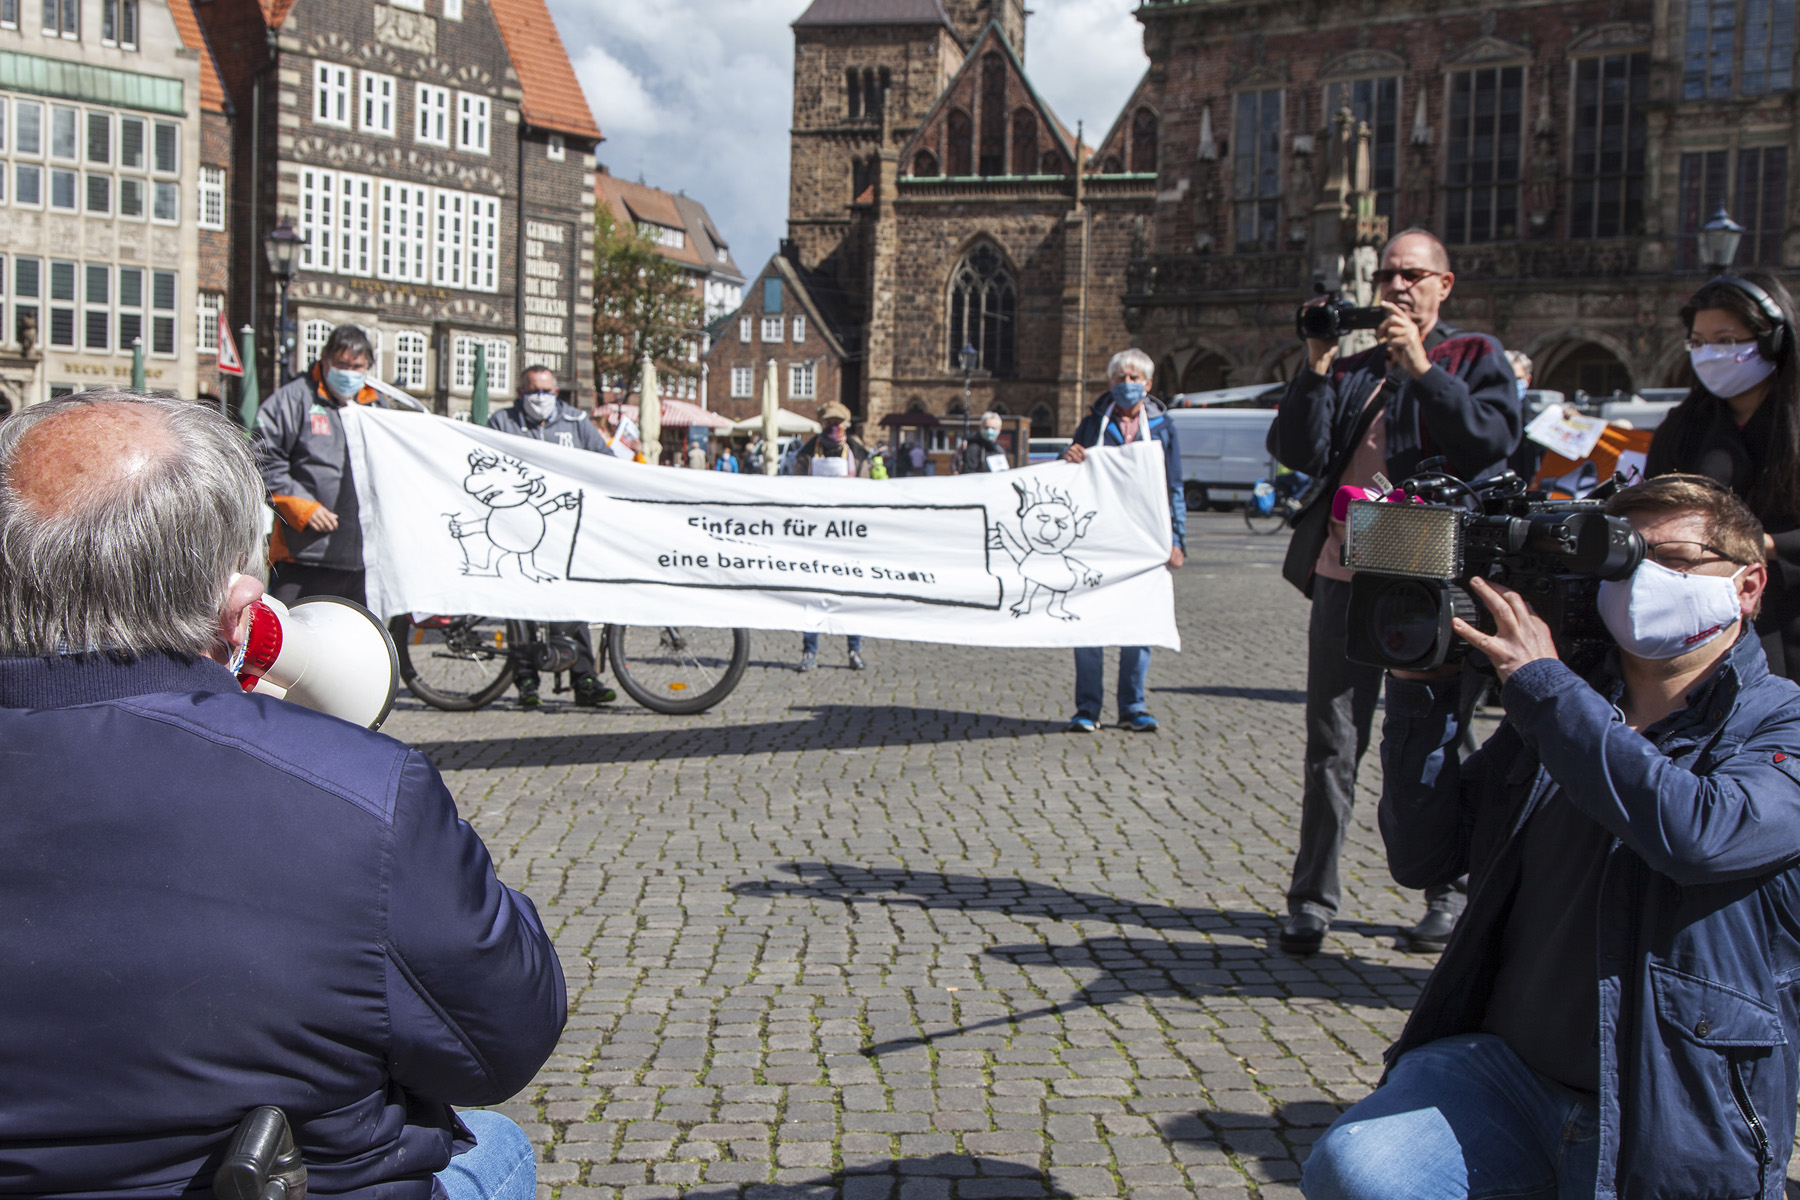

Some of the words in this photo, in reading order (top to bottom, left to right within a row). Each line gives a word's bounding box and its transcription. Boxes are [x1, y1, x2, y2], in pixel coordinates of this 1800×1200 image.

[687, 516, 774, 536] Einfach
[783, 518, 817, 537] für
[825, 520, 868, 538] Alle
[657, 550, 709, 568] eine
[717, 552, 863, 578] barrierefreie
